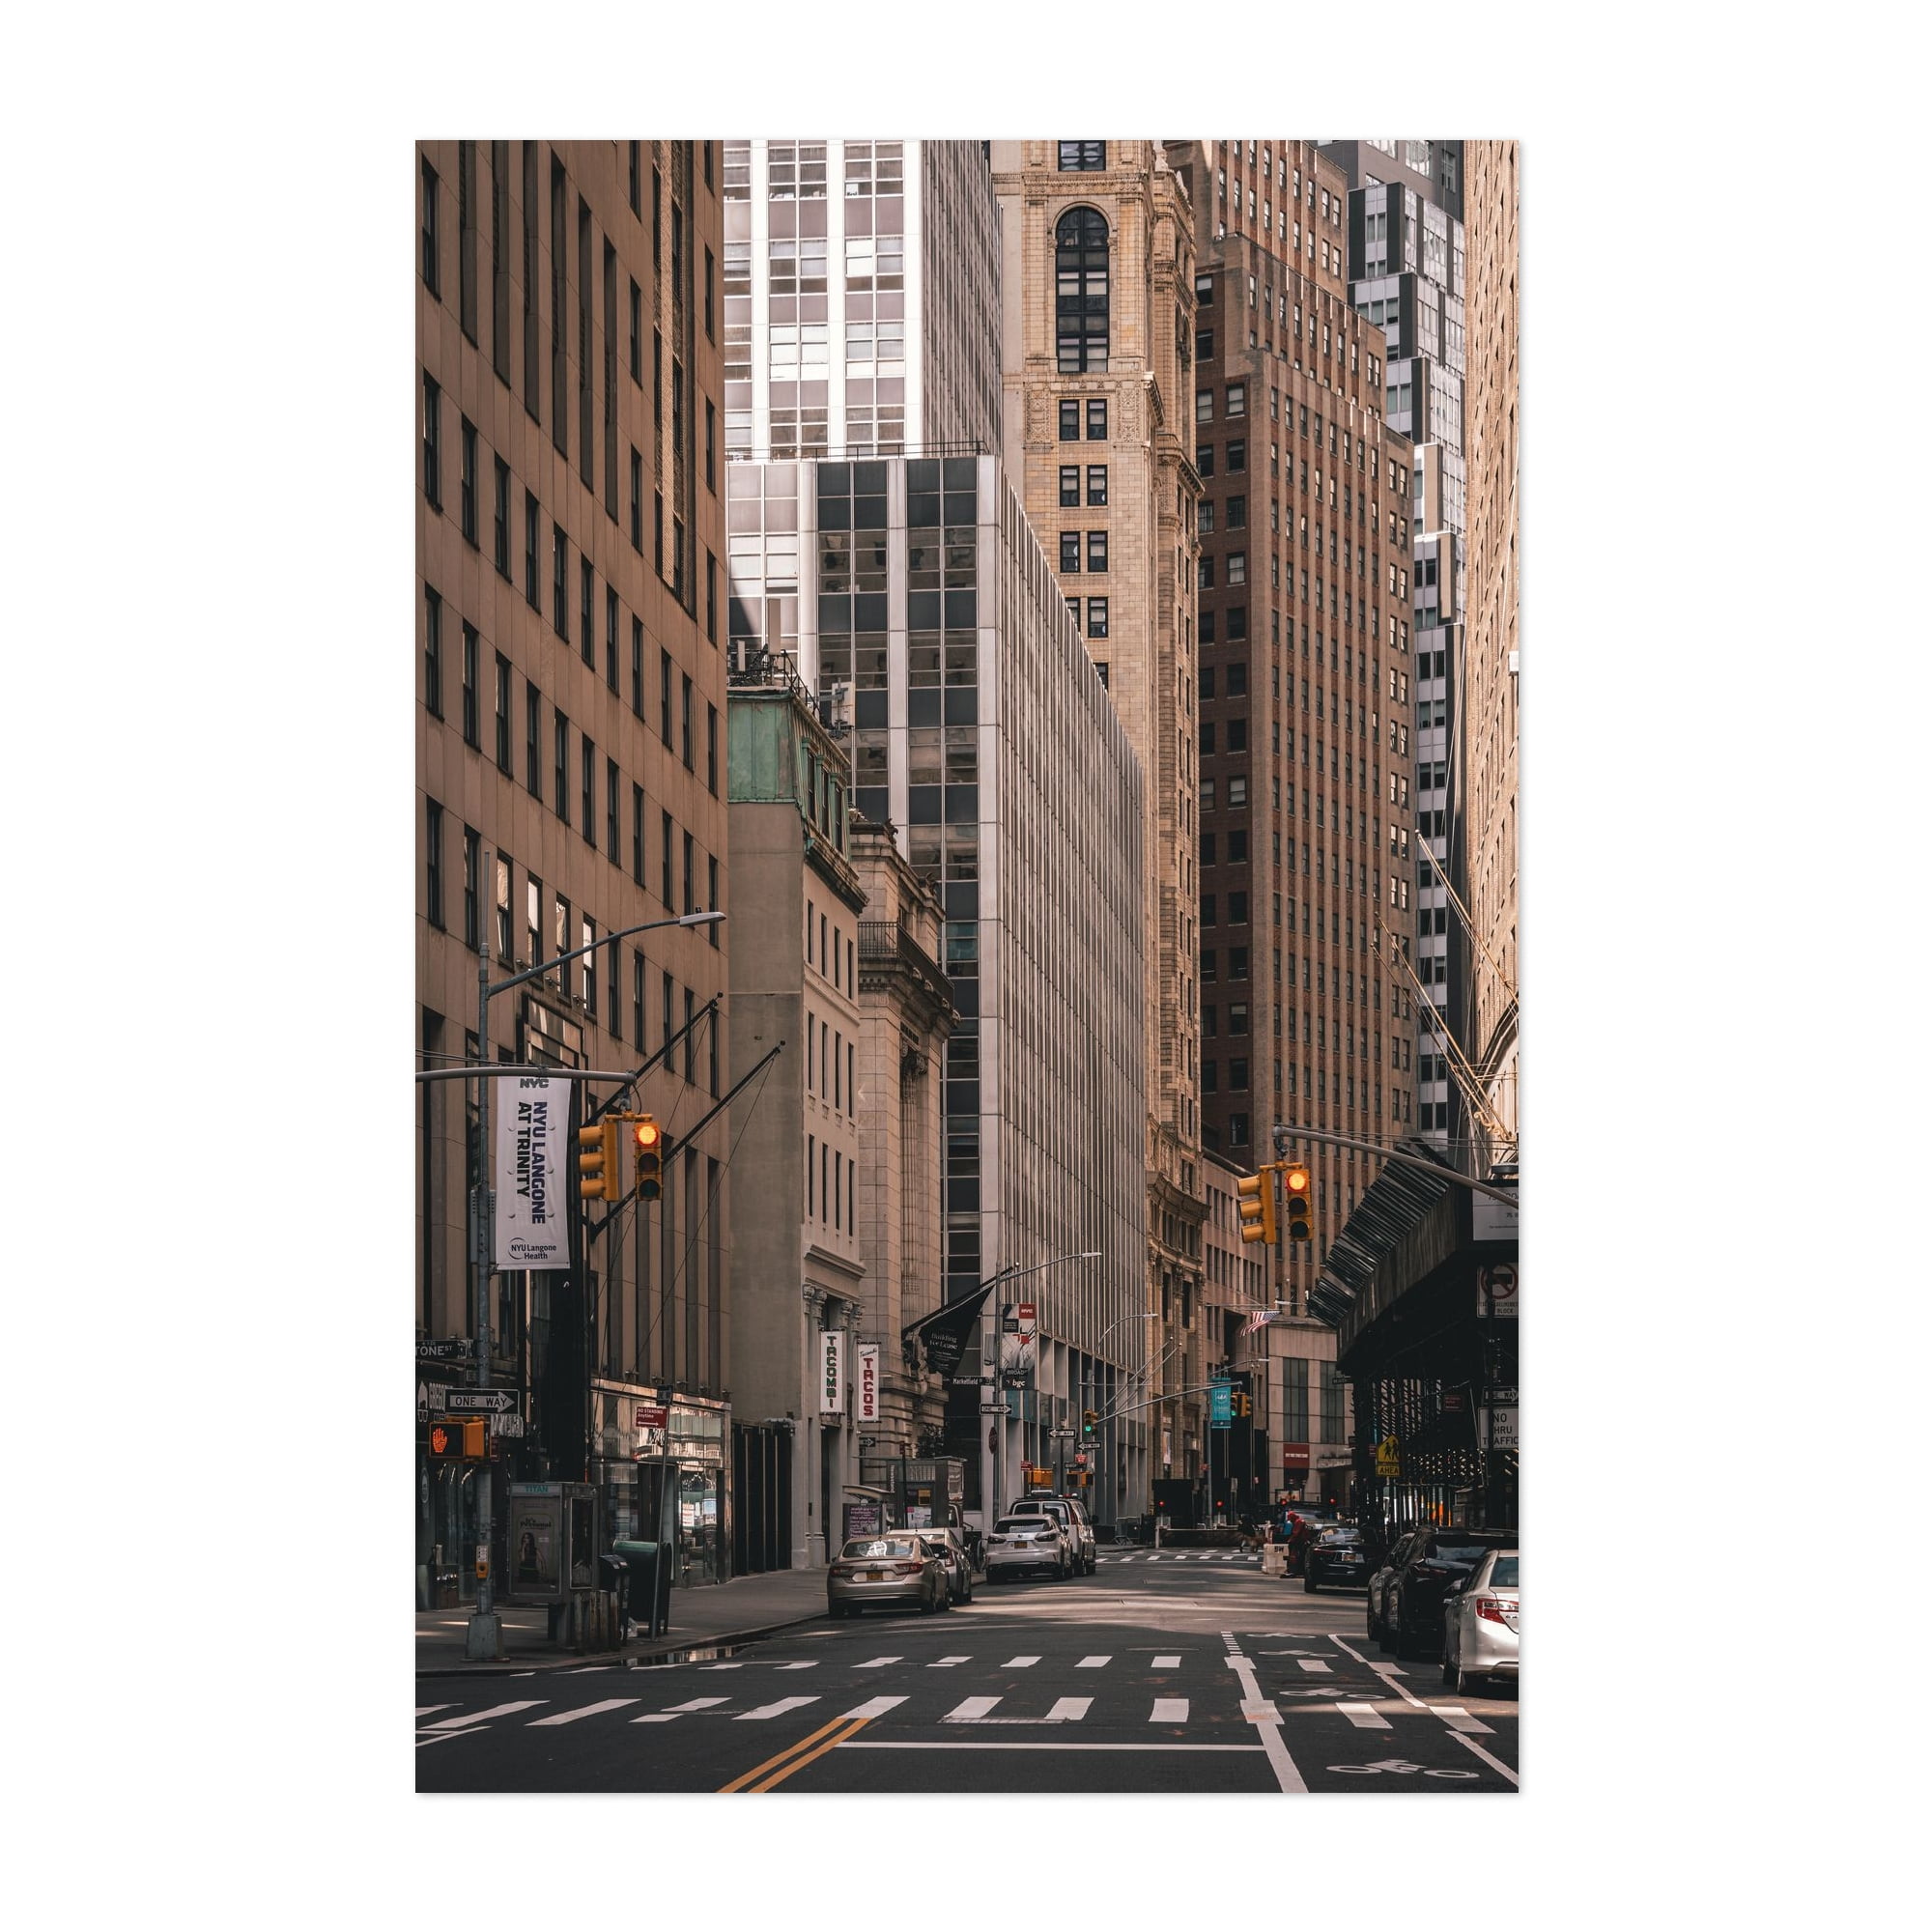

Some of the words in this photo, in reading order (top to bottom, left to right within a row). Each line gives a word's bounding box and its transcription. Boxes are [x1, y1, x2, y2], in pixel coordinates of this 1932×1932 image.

[520, 1078, 549, 1089] NYC
[518, 1101, 532, 1124] AT
[533, 1101, 548, 1138] NYU
[517, 1127, 530, 1198] TRINITY
[531, 1142, 546, 1224] LANGONE
[526, 1244, 557, 1254] Langone
[827, 1336, 838, 1408] TACOMBI
[864, 1357, 874, 1417] TACOS
[1012, 1379, 1026, 1388] bgc
[455, 1397, 476, 1406] ONE
[486, 1397, 507, 1406] WAY
[1492, 1413, 1507, 1423] NO
[1493, 1426, 1513, 1435] HRU
[1483, 1436, 1519, 1446] TAFFIC
